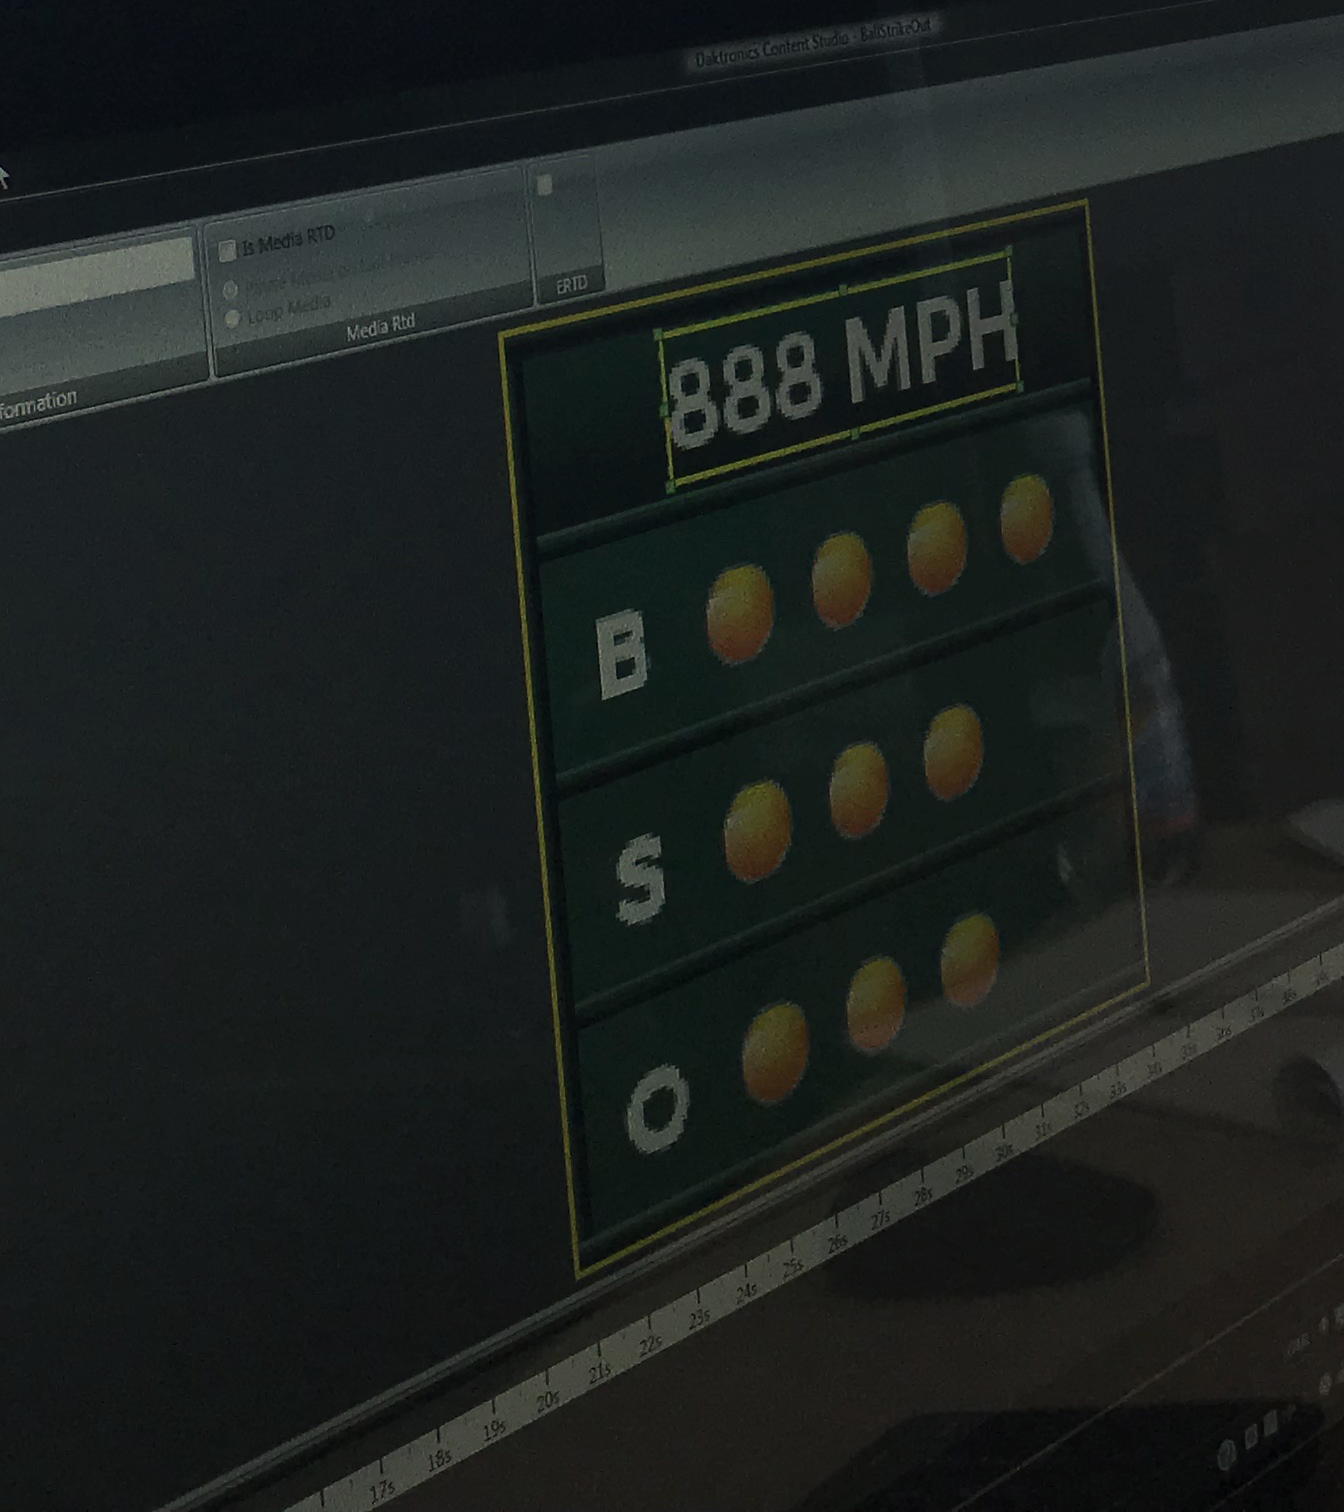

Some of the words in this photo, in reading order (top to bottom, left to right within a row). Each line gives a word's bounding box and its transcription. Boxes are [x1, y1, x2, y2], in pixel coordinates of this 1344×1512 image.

[696, 48, 759, 68] Daktronics
[763, 40, 810, 56] Content
[813, 33, 849, 48] Studio
[242, 239, 255, 257] Is
[258, 231, 304, 254] Media
[307, 223, 336, 245] RTD
[287, 294, 332, 318] Media
[555, 275, 588, 294] ERTD
[346, 319, 388, 342] Media
[391, 313, 416, 334] Rtd
[669, 331, 823, 450] 888
[845, 279, 1018, 404] MPH
[595, 608, 651, 700] B
[615, 833, 665, 924] S
[626, 1064, 689, 1153] O
[370, 1480, 395, 1505] 17s
[428, 1449, 453, 1473] 18s
[483, 1420, 507, 1441] 19s
[536, 1389, 560, 1413] 20s
[589, 1365, 610, 1385] 21s
[639, 1336, 662, 1356] 22s
[689, 1309, 711, 1330] 23s
[736, 1283, 757, 1305] 24s
[783, 1257, 804, 1278] 25s
[828, 1235, 848, 1254] 26s
[871, 1210, 891, 1230] 27s
[915, 1188, 933, 1206] 28s
[955, 1165, 974, 1184] 29s
